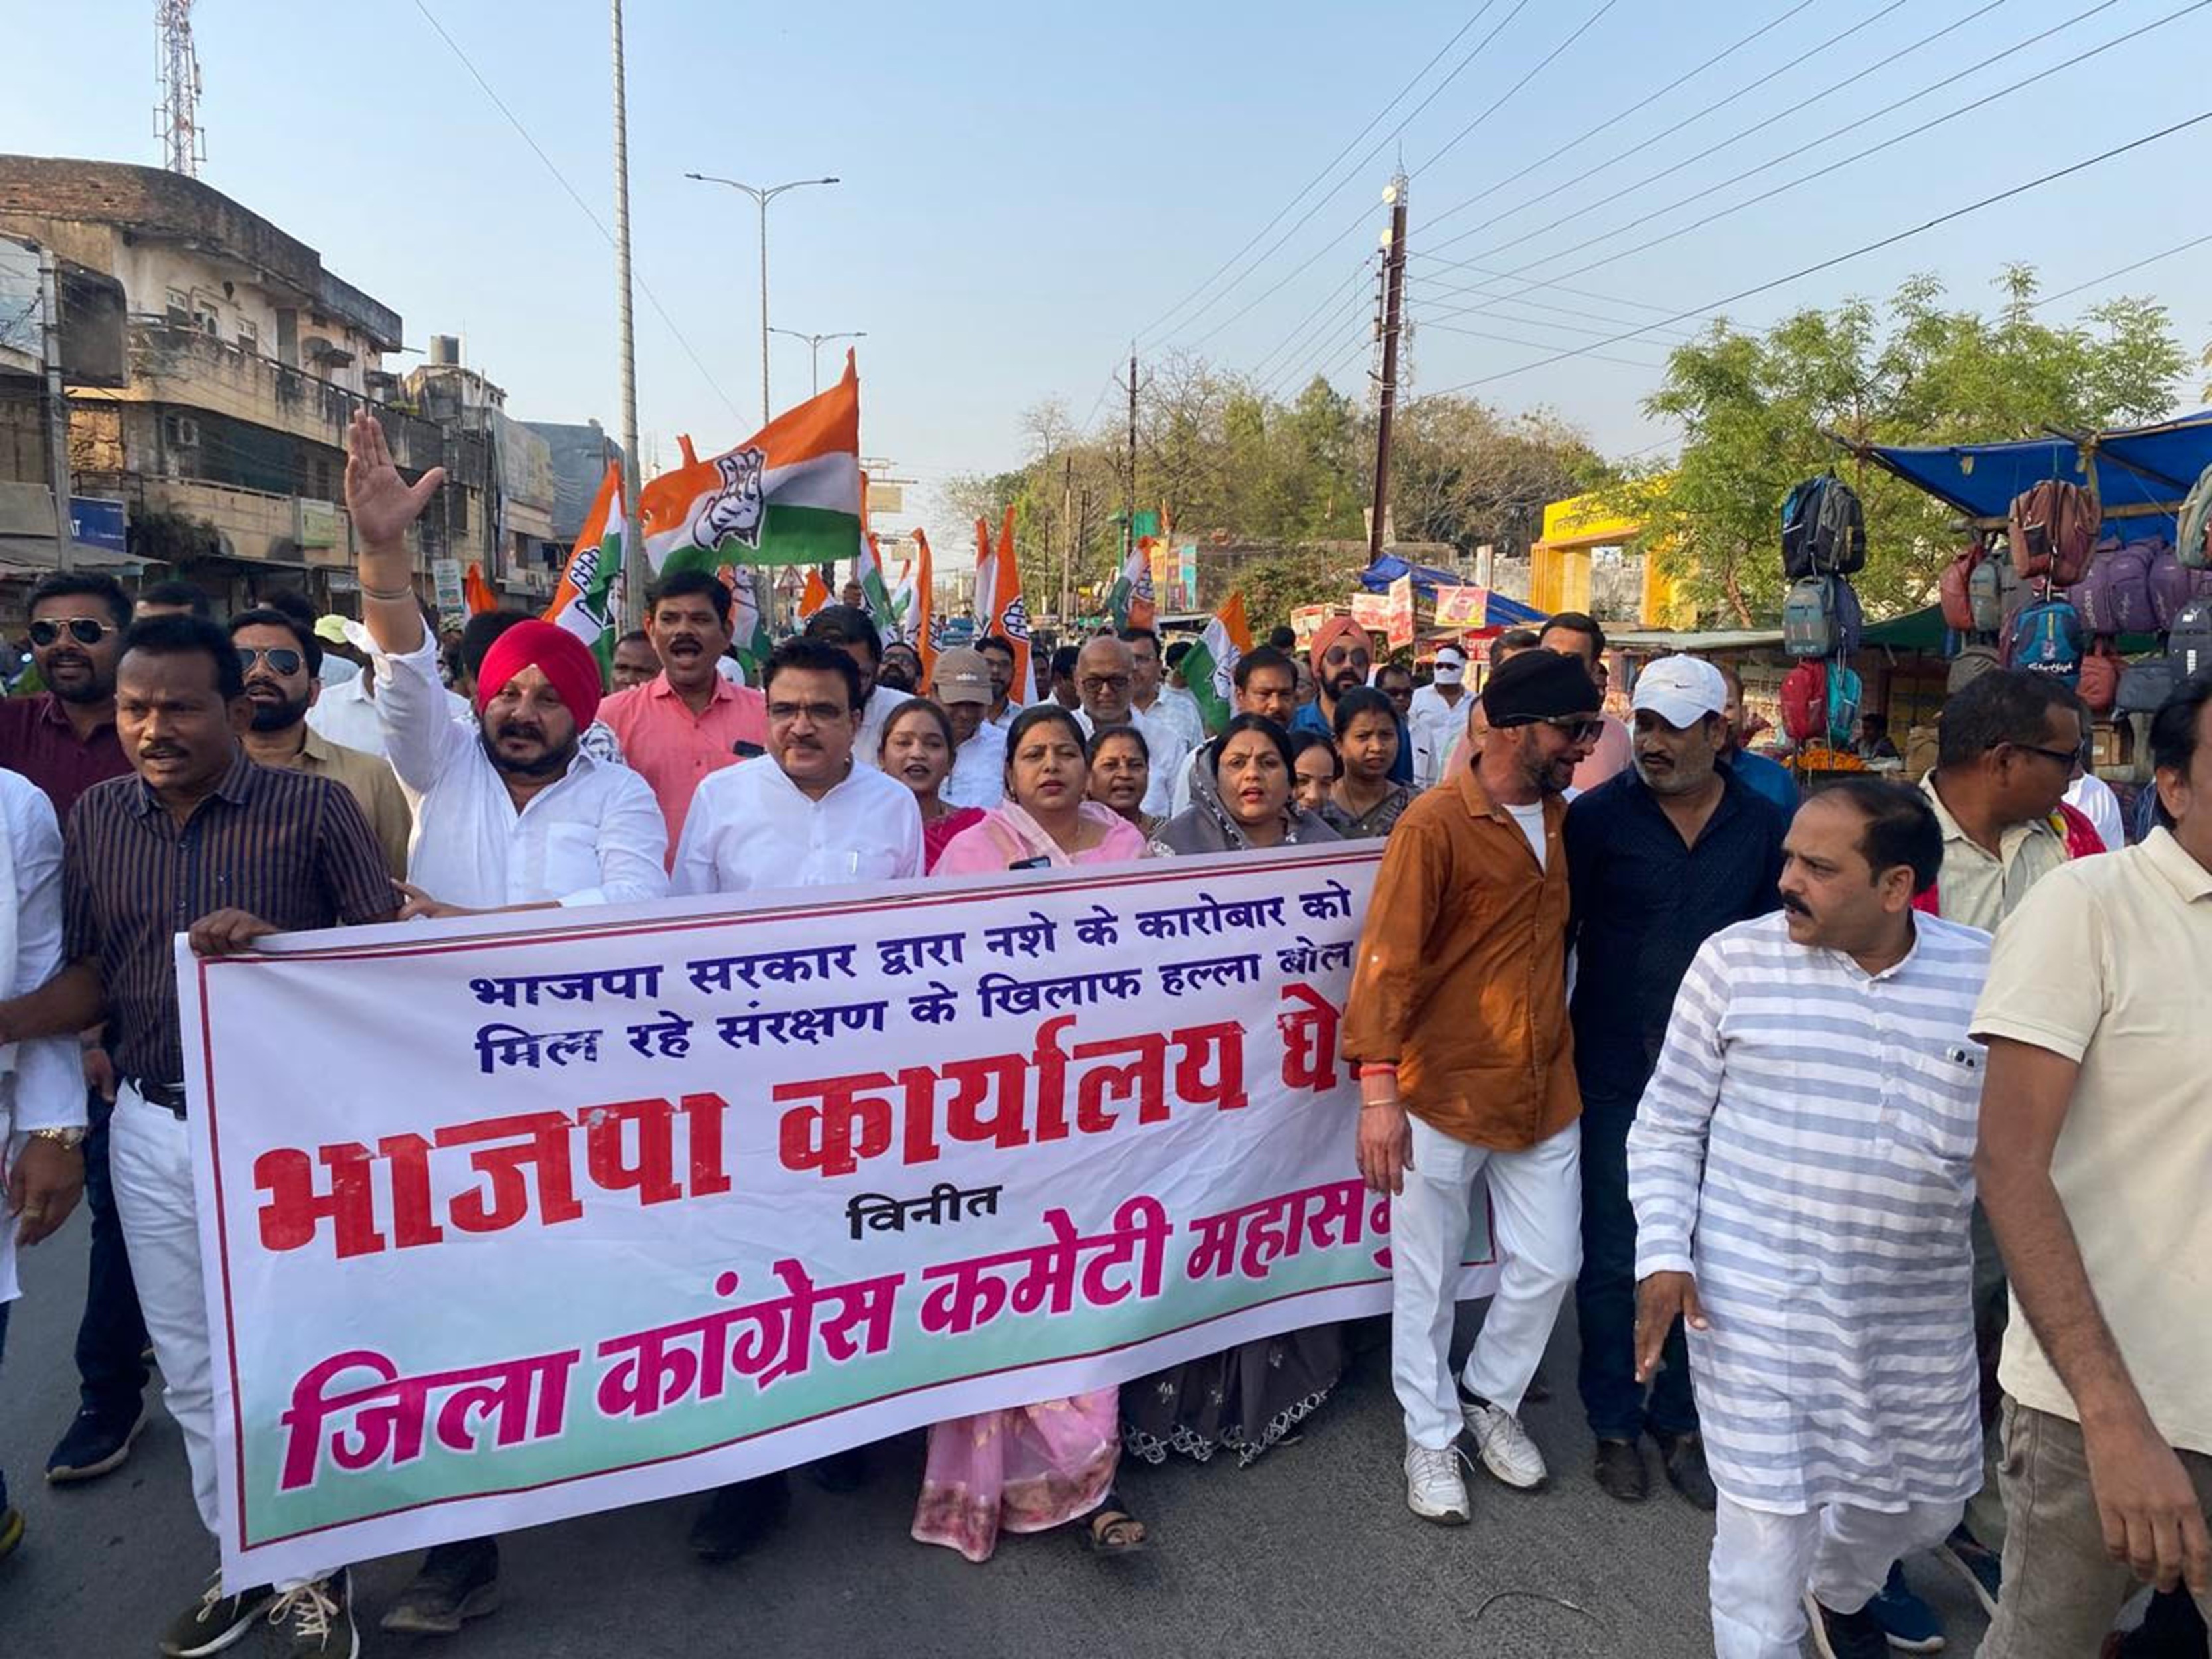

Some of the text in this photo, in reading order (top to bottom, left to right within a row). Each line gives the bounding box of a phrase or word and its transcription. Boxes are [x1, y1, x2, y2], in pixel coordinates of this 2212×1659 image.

[470, 879, 1351, 1007] भाजपा सरकार द्वारा नशे के कारोबार को
[474, 936, 1355, 1074] मिल रहे संरक्षण के खिलाफ हल्ला बोल
[254, 981, 1354, 1259] भाजपा कार्यालय घे
[846, 1183, 1003, 1240] विनीत
[282, 1350, 581, 1488] जिला
[597, 1259, 905, 1416] कांग्रेस
[921, 1195, 1173, 1333] कमेटी
